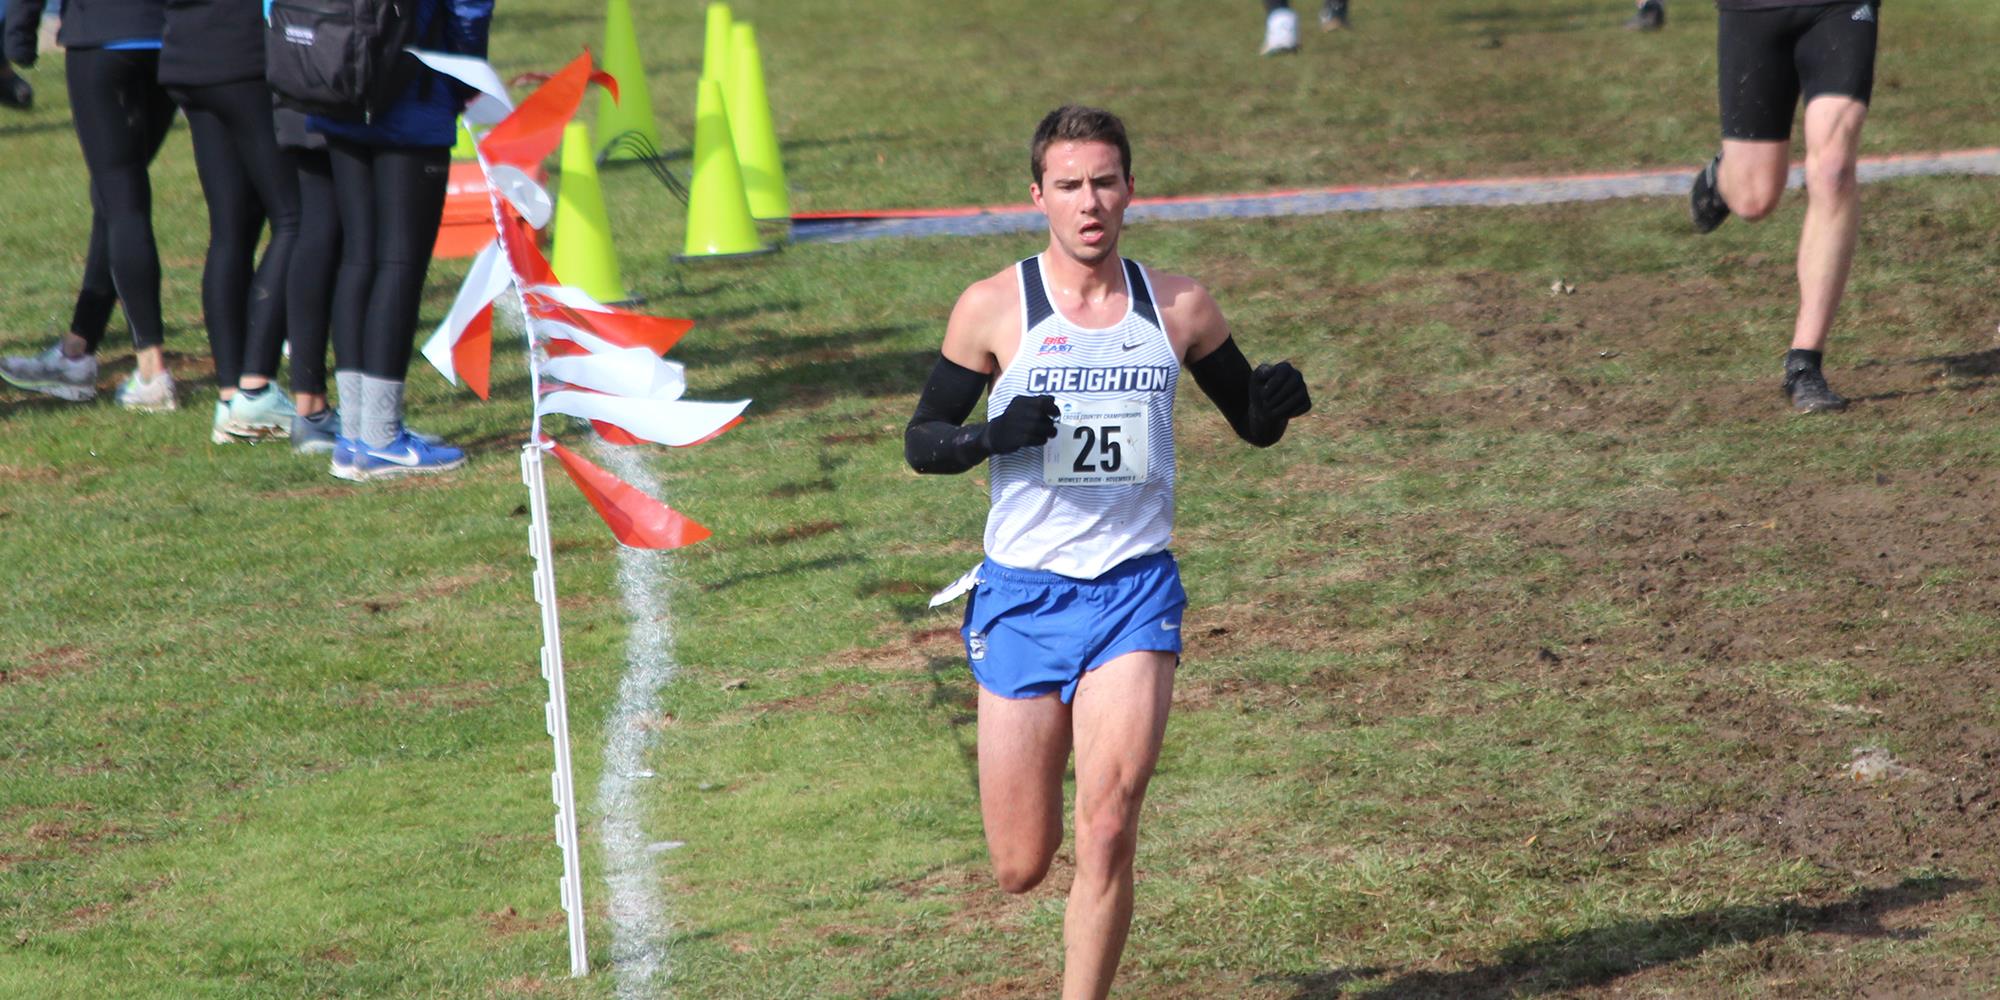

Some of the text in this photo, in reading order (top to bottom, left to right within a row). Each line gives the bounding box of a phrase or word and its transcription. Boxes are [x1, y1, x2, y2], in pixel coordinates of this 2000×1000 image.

[1039, 344, 1074, 352] EAST
[1027, 366, 1169, 392] CREIGHTON
[1073, 426, 1121, 472] 25
